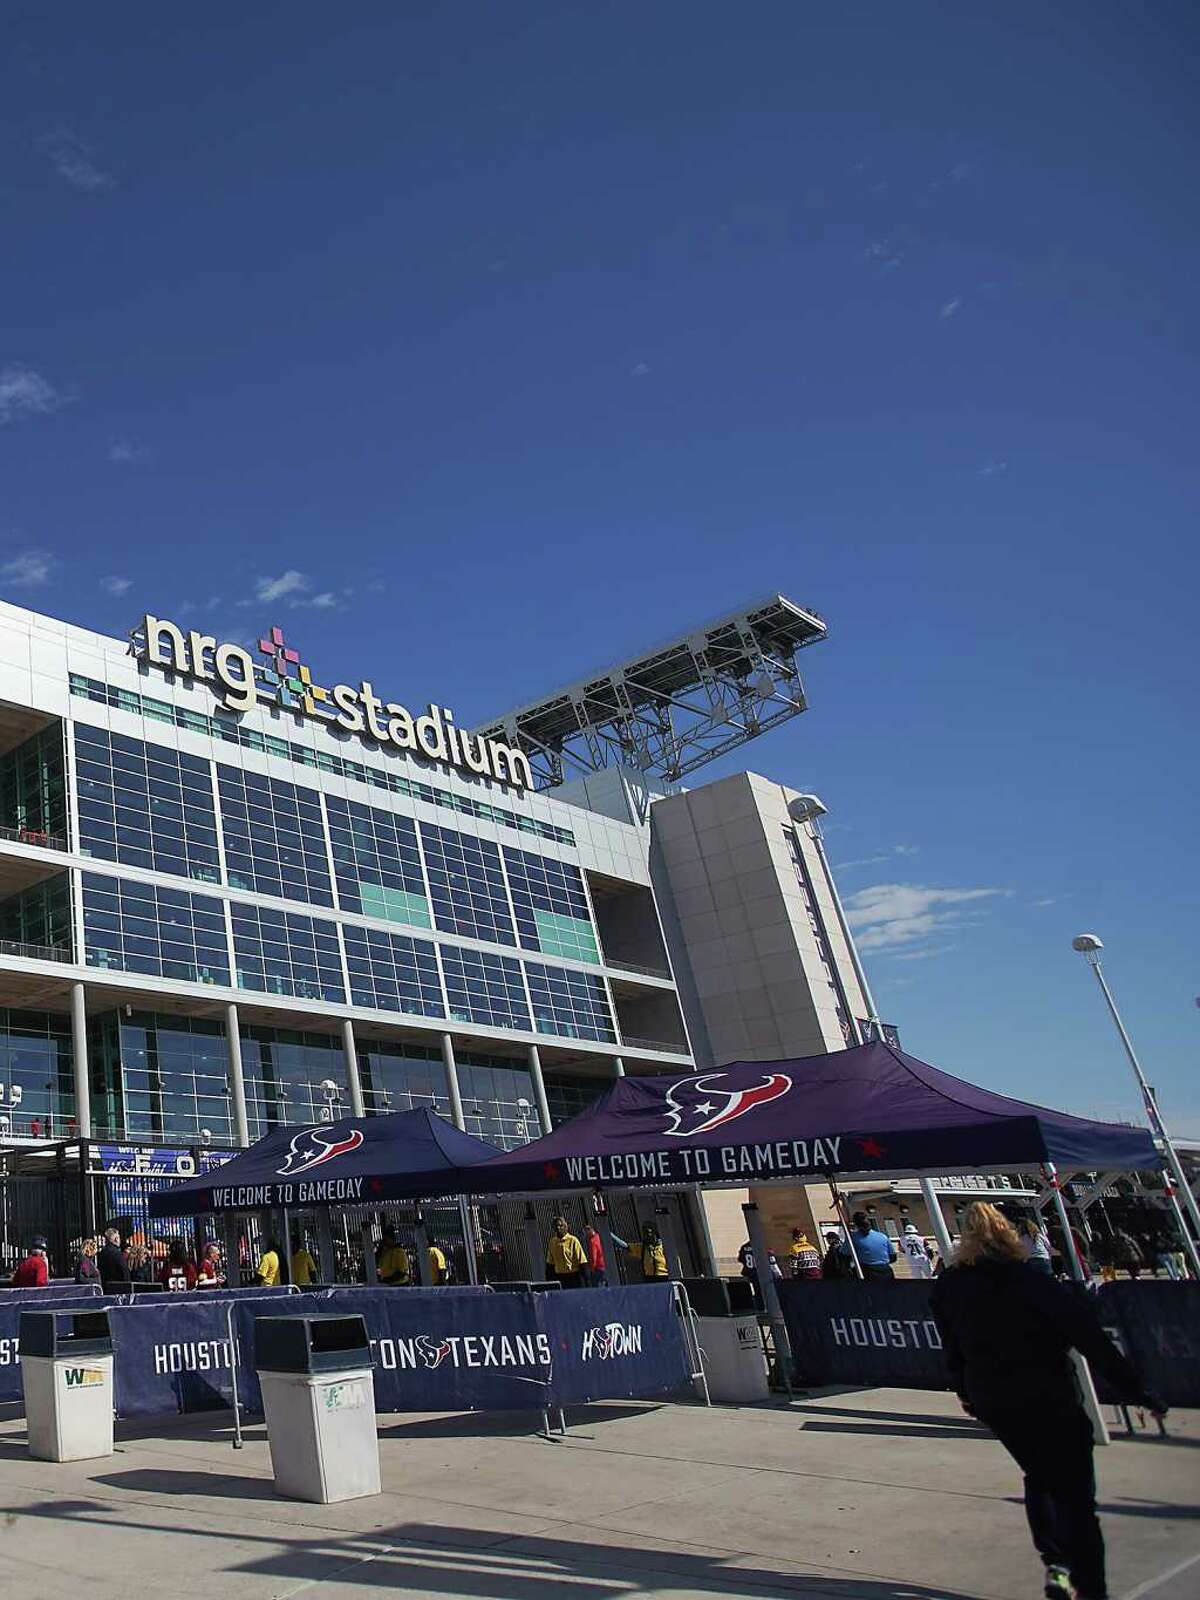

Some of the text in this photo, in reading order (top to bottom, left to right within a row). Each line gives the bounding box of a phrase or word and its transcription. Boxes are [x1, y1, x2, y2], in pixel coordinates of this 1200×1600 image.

[145, 613, 534, 790] nrg stadium
[566, 1137, 842, 1181] WELCOME TO GAMEDAY
[212, 1186, 272, 1207] WELCOME
[276, 1184, 293, 1203] TO
[299, 1177, 363, 1202] GAMEDAY
[446, 1333, 552, 1369] TEXANS
[830, 1316, 943, 1351] HOUSTO
[154, 1339, 241, 1375] HOUSTO
